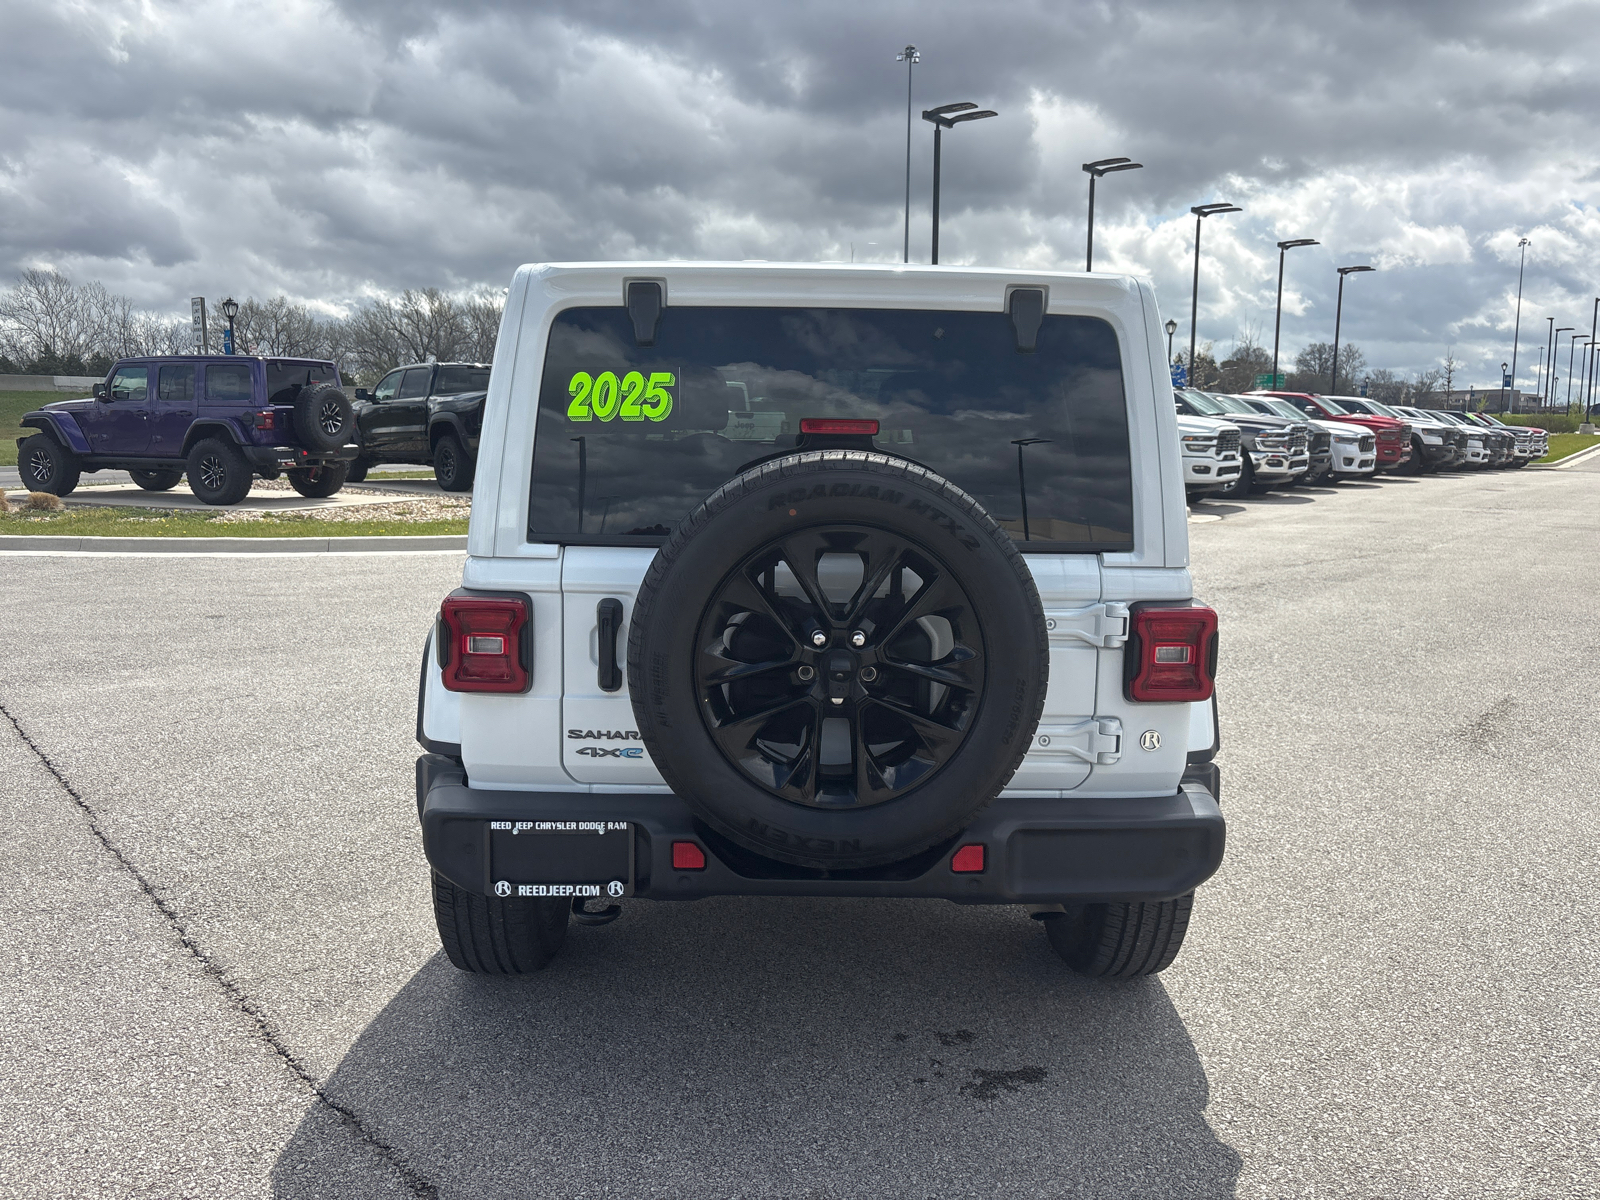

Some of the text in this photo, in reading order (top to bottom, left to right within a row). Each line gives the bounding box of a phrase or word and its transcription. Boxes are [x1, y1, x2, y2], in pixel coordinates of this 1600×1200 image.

[567, 371, 676, 422] 2025
[734, 421, 755, 430] Jeep
[768, 483, 903, 510] ROADIAN
[567, 729, 643, 740] SAHAR
[491, 821, 627, 830] REED JEEP CHRYSLER DODGE RAM
[748, 818, 860, 851] NEXEN
[518, 885, 600, 896] REEDJEEP.COM
